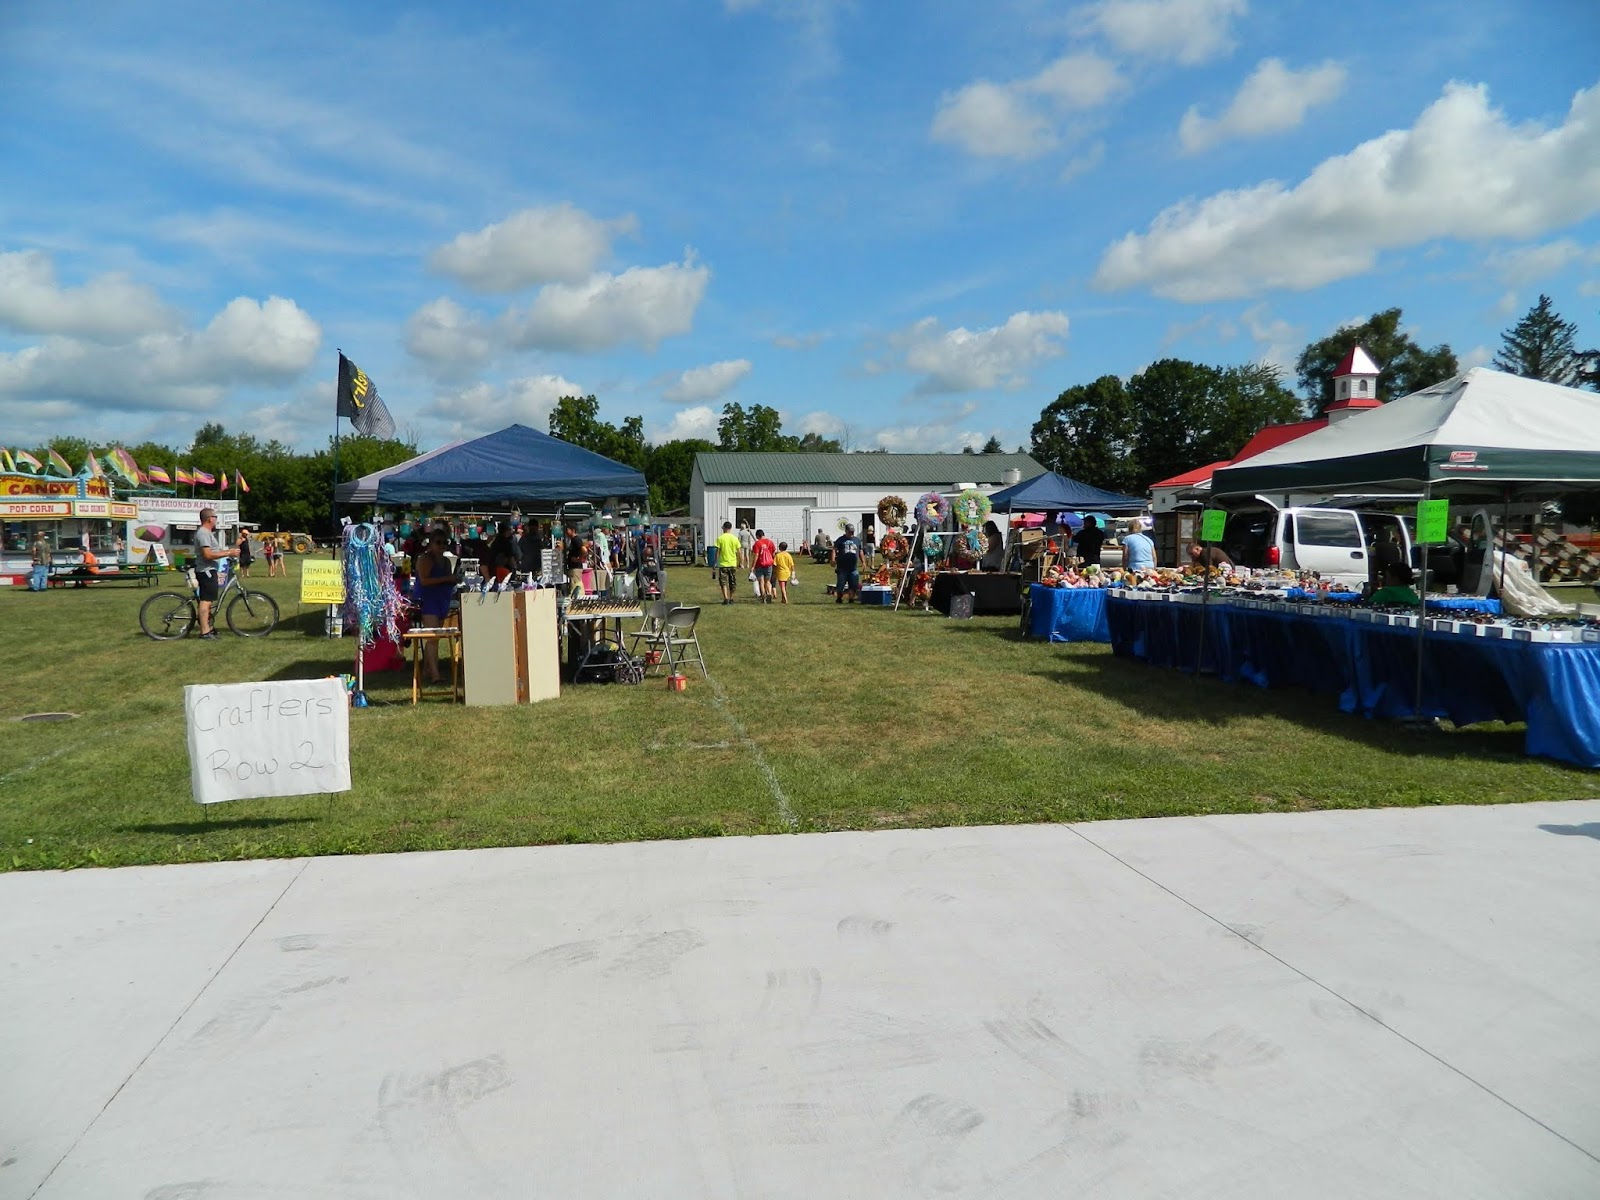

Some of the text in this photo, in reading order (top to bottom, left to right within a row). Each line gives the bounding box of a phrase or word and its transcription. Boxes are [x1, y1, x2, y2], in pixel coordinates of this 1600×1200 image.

[8, 483, 73, 495] CANDY
[9, 505, 54, 513] POP CORN
[151, 500, 192, 508] FASHIONED
[192, 689, 333, 732] Crafters
[206, 740, 324, 782] Row 2
